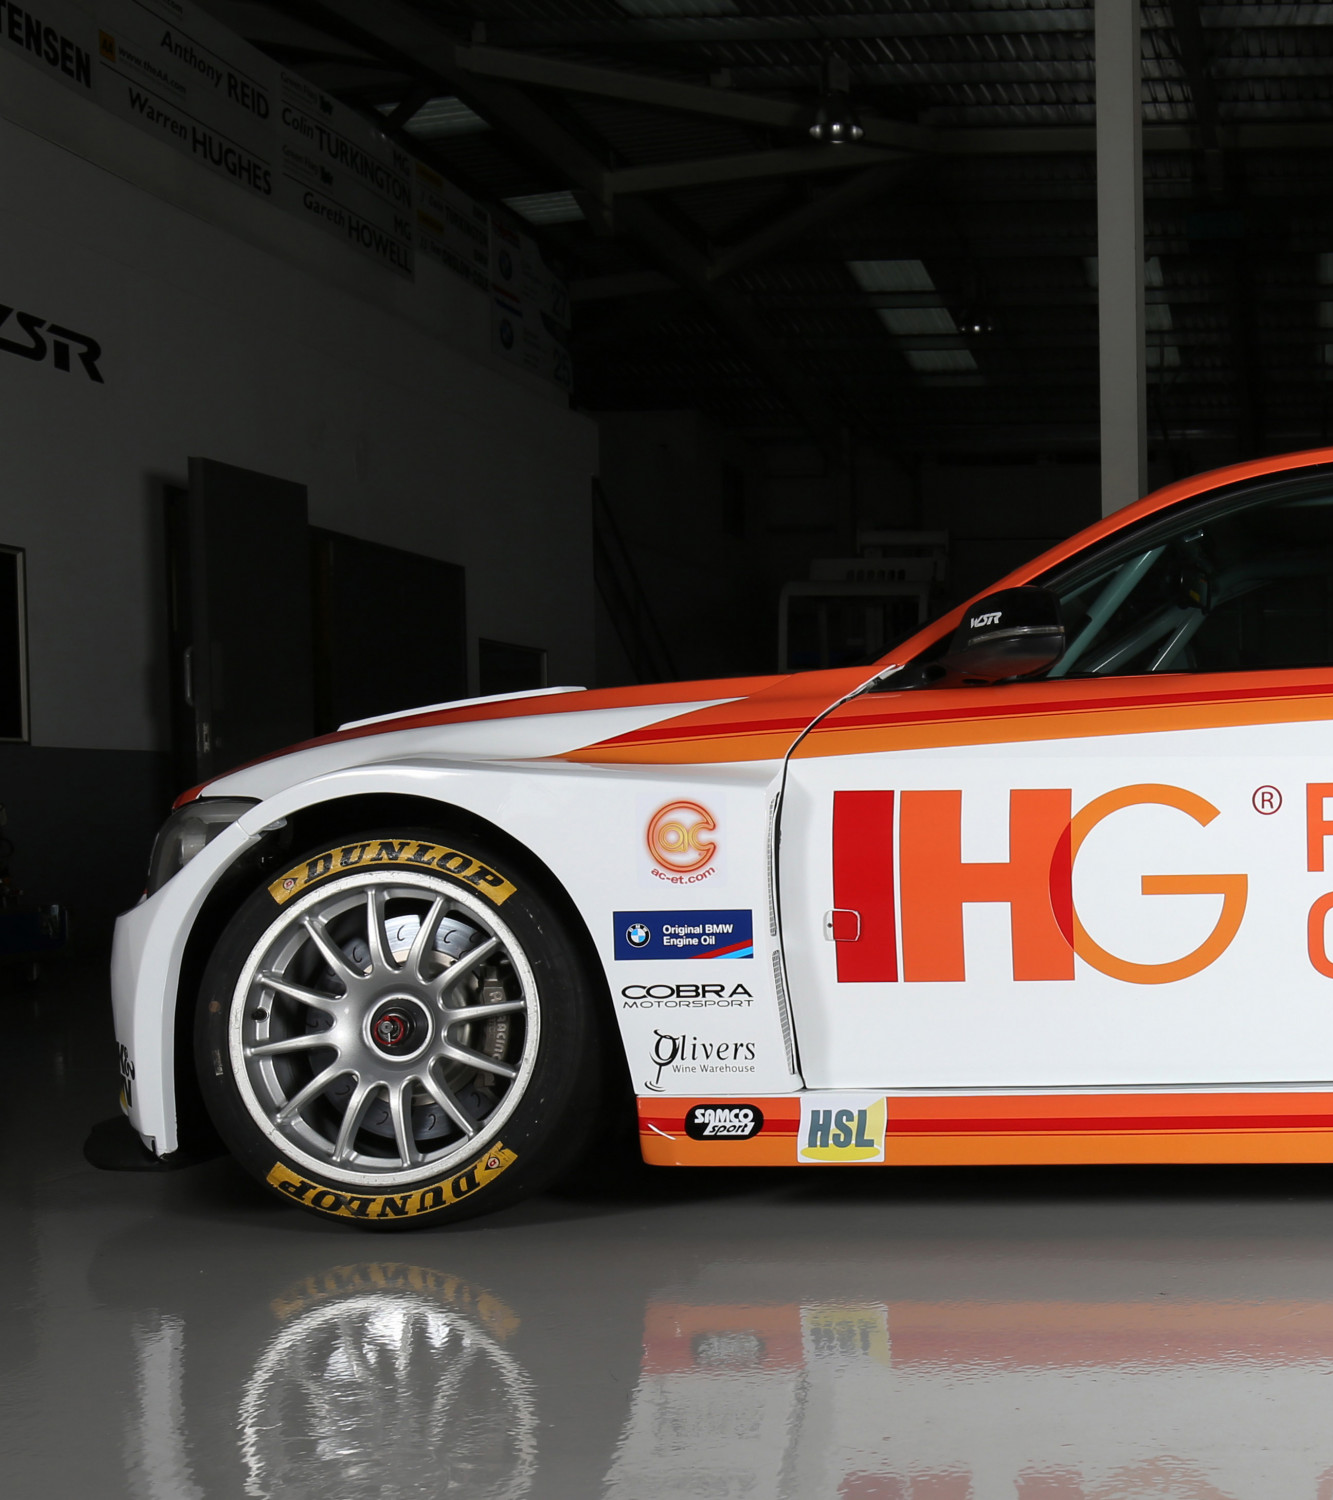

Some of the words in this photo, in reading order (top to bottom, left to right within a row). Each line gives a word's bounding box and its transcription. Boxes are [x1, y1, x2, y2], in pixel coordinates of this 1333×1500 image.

[160, 30, 223, 88] Anthony
[227, 71, 270, 120] REID
[128, 87, 188, 141] Warren
[192, 126, 272, 196] HUGHES
[281, 107, 314, 140] Colin
[315, 124, 412, 209] TURKINGTON
[303, 191, 346, 228] Gareth
[348, 214, 412, 274] HOWELL
[303, 840, 505, 888] DUNLOP
[650, 866, 717, 885] ac-et.com
[662, 924, 703, 936] Original
[705, 924, 734, 934] BMW
[662, 936, 699, 948] Engine
[701, 935, 716, 946] Oil
[621, 983, 754, 1000] COBRA
[622, 1000, 754, 1009] MOTORSPORT
[648, 1029, 756, 1067] Olivers
[671, 1063, 697, 1074] Wine
[699, 1062, 756, 1074] Warehouse
[694, 1108, 755, 1124] SAMCO
[708, 1122, 749, 1136] sport
[807, 1109, 875, 1148] HSL
[278, 1163, 481, 1218] DUNLOP
